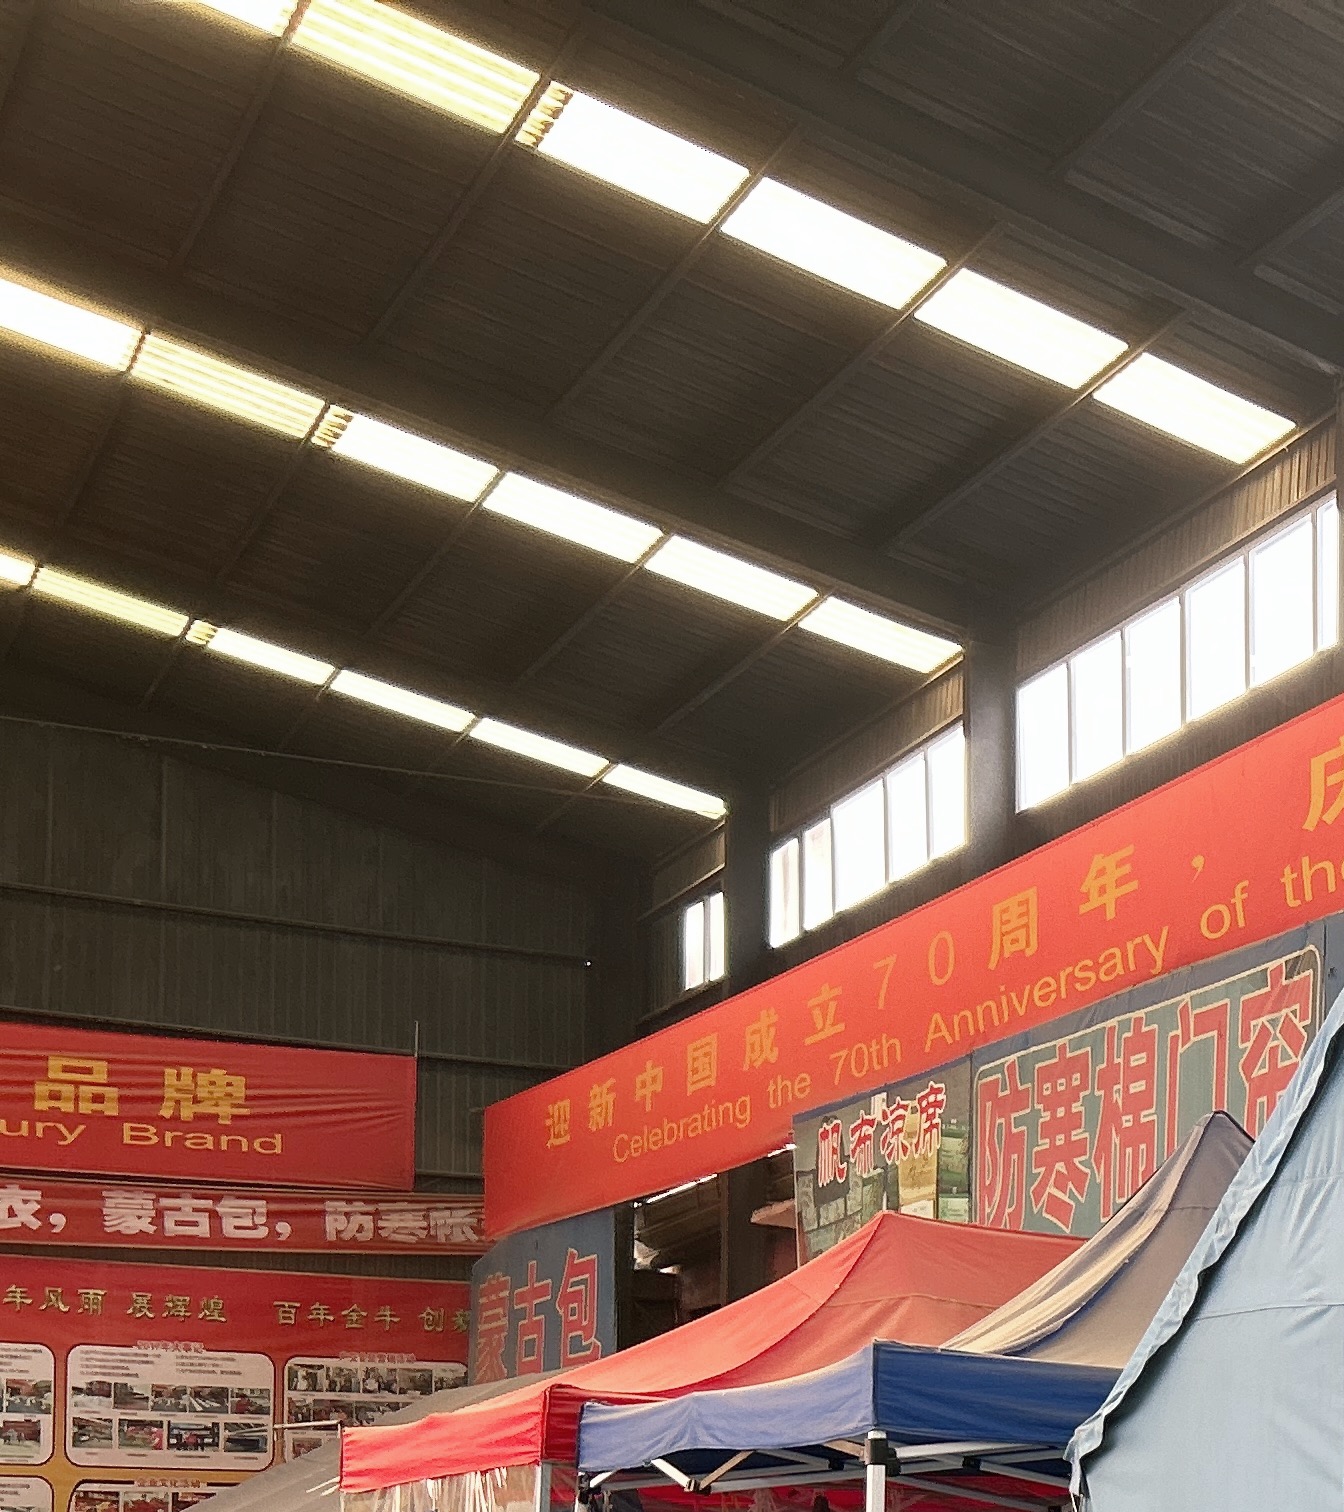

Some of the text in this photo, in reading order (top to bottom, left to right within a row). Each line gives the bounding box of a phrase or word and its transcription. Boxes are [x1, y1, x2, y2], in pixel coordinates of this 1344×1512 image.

[612, 1094, 752, 1163] Celebrating
[767, 1071, 812, 1109] the
[830, 1032, 902, 1087] 70th
[925, 926, 1169, 1053] Anniversary
[1200, 880, 1250, 940] of
[34, 1054, 250, 1125] 品牌
[122, 1122, 283, 1155] Brand
[273, 1300, 401, 1332] 百年金牛
[474, 1248, 602, 1384] 蒙古包
